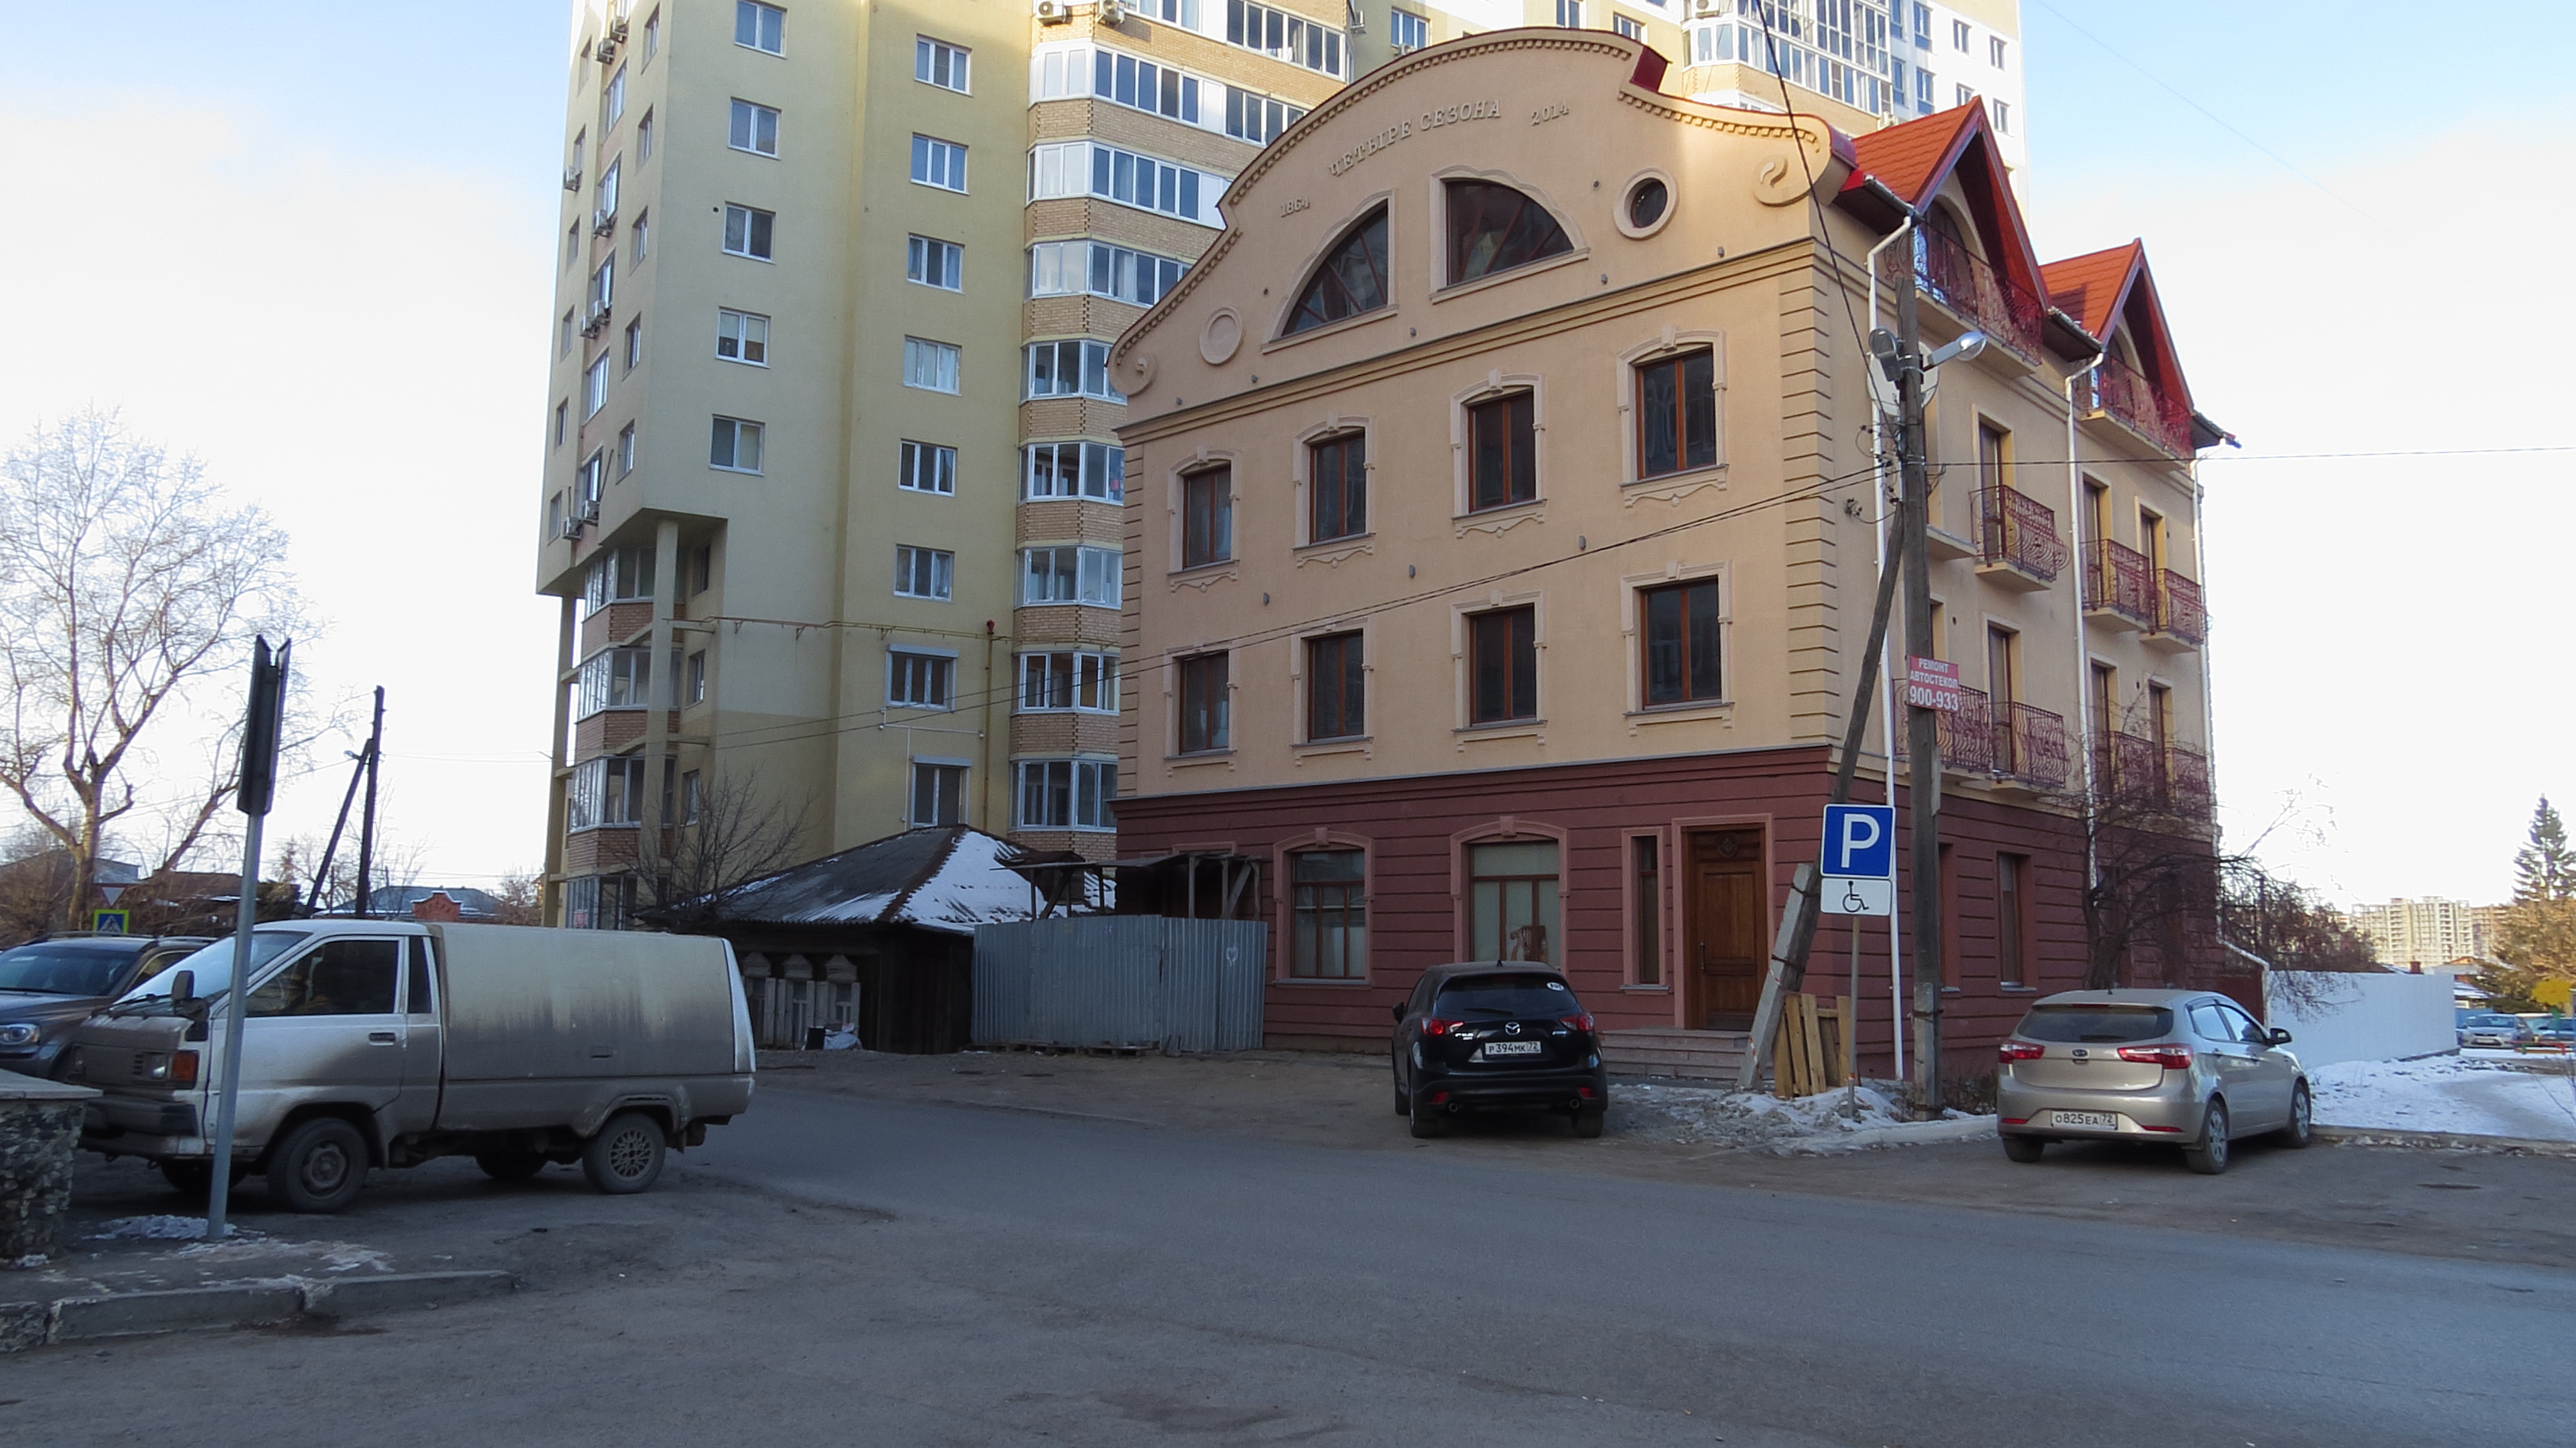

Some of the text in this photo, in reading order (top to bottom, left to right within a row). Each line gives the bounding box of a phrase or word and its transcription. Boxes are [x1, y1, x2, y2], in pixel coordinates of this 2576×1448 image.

[1531, 102, 1569, 126] 2014
[1329, 99, 1501, 177] ЧЕТЫРЕ СЕЗОНА
[1280, 196, 1311, 218] 1864
[1918, 658, 1949, 674] РЕМОНТ
[1909, 685, 1958, 711] 900-933
[1841, 813, 1880, 868] P
